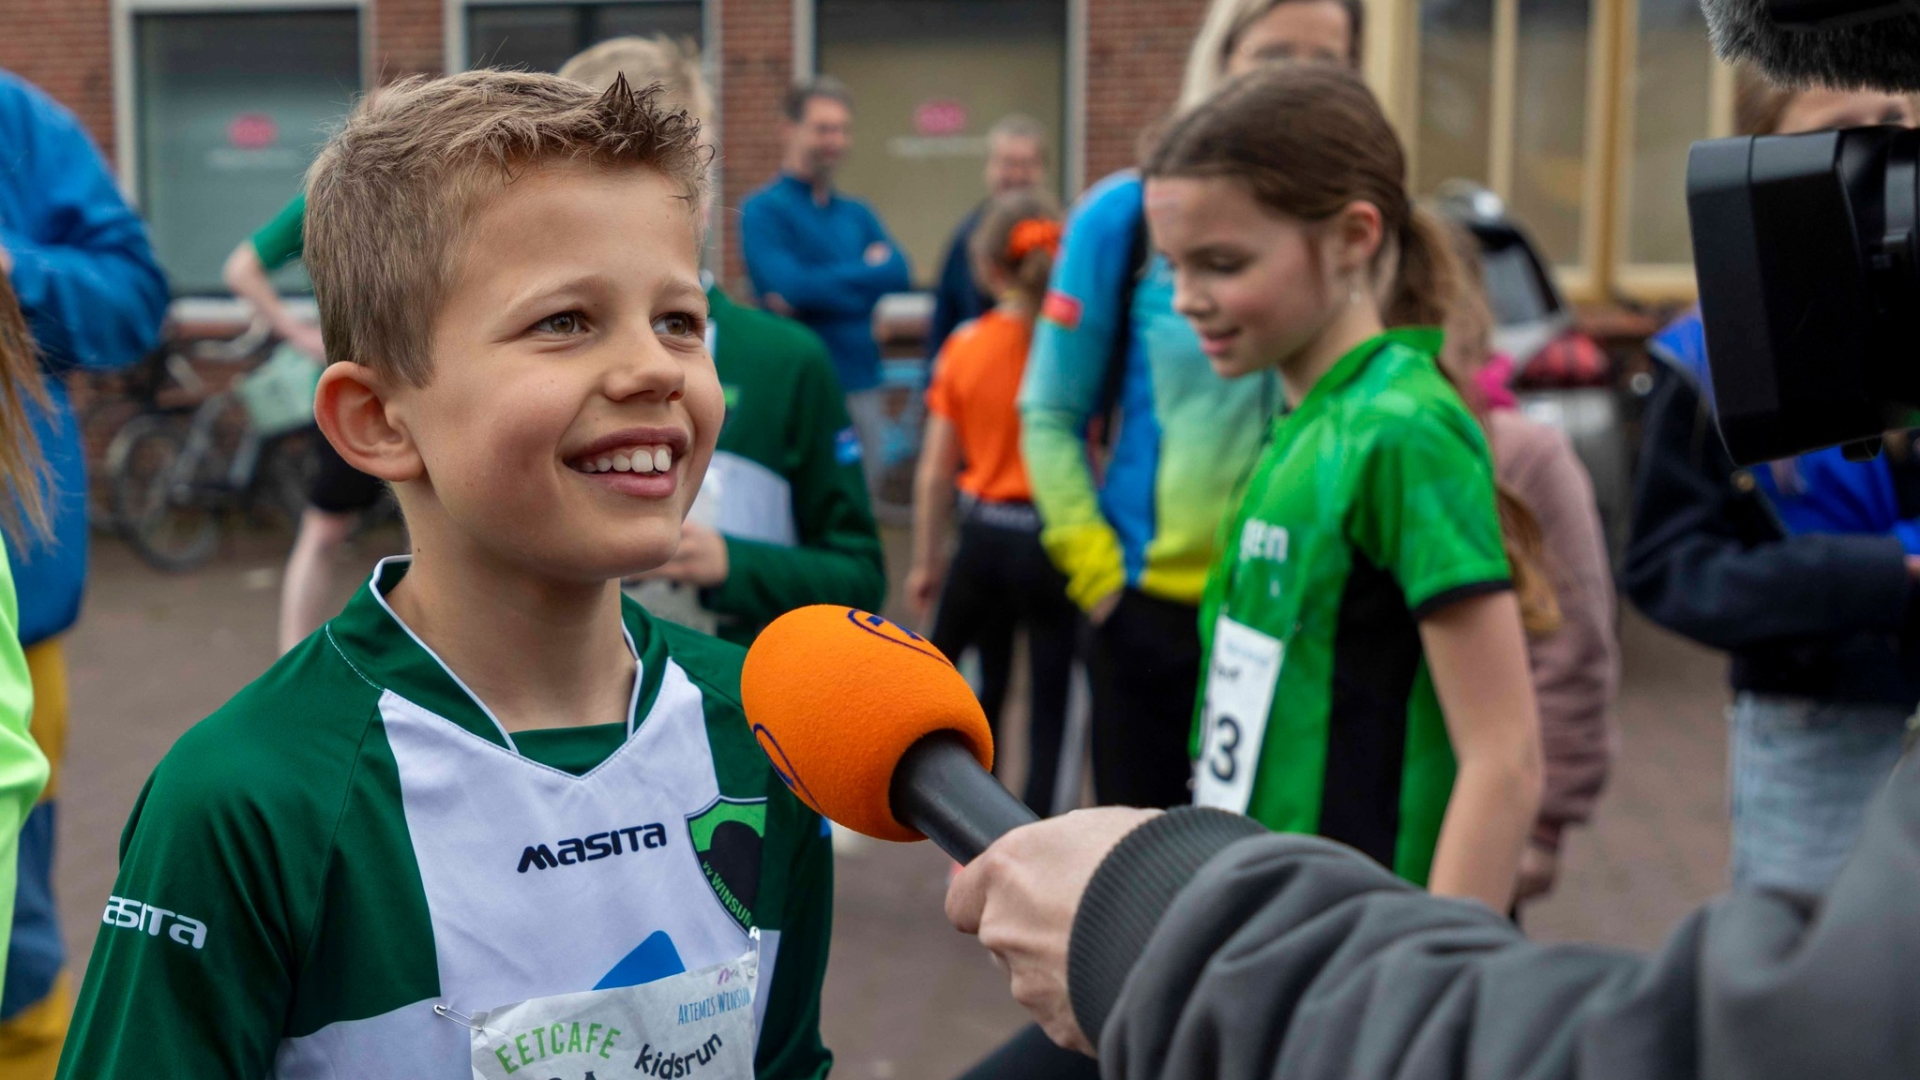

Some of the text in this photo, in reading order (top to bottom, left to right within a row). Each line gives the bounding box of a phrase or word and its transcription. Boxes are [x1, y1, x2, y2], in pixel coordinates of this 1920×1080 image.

[102, 895, 208, 949] ASITA
[677, 996, 716, 1025] ARTEMIS
[495, 1022, 621, 1074] EETCAFE
[634, 1033, 723, 1080] kidsrun
